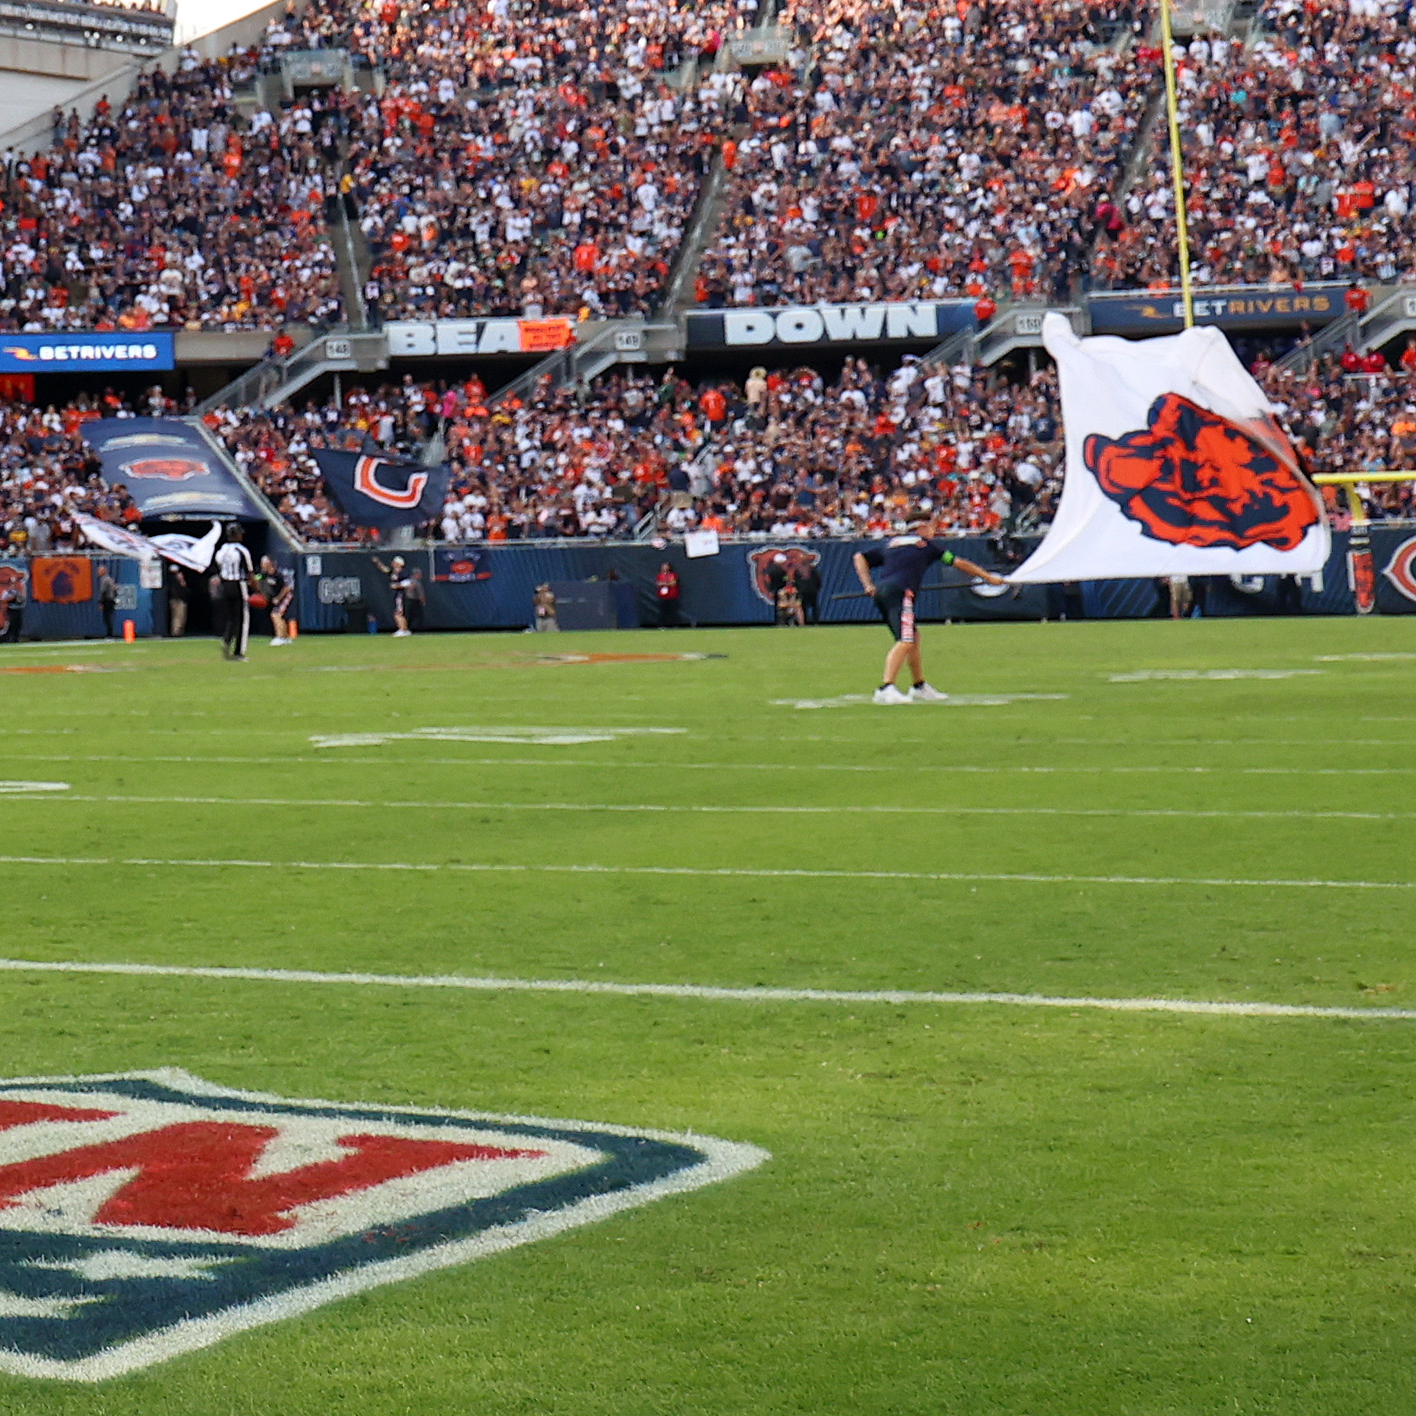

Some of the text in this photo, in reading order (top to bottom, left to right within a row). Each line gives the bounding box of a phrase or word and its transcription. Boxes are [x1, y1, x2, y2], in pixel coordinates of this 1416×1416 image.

[1173, 295, 1330, 318] BETRIVERS
[388, 321, 521, 355] BEA
[724, 305, 937, 345] DOWN
[39, 345, 157, 360] BETRIVERS
